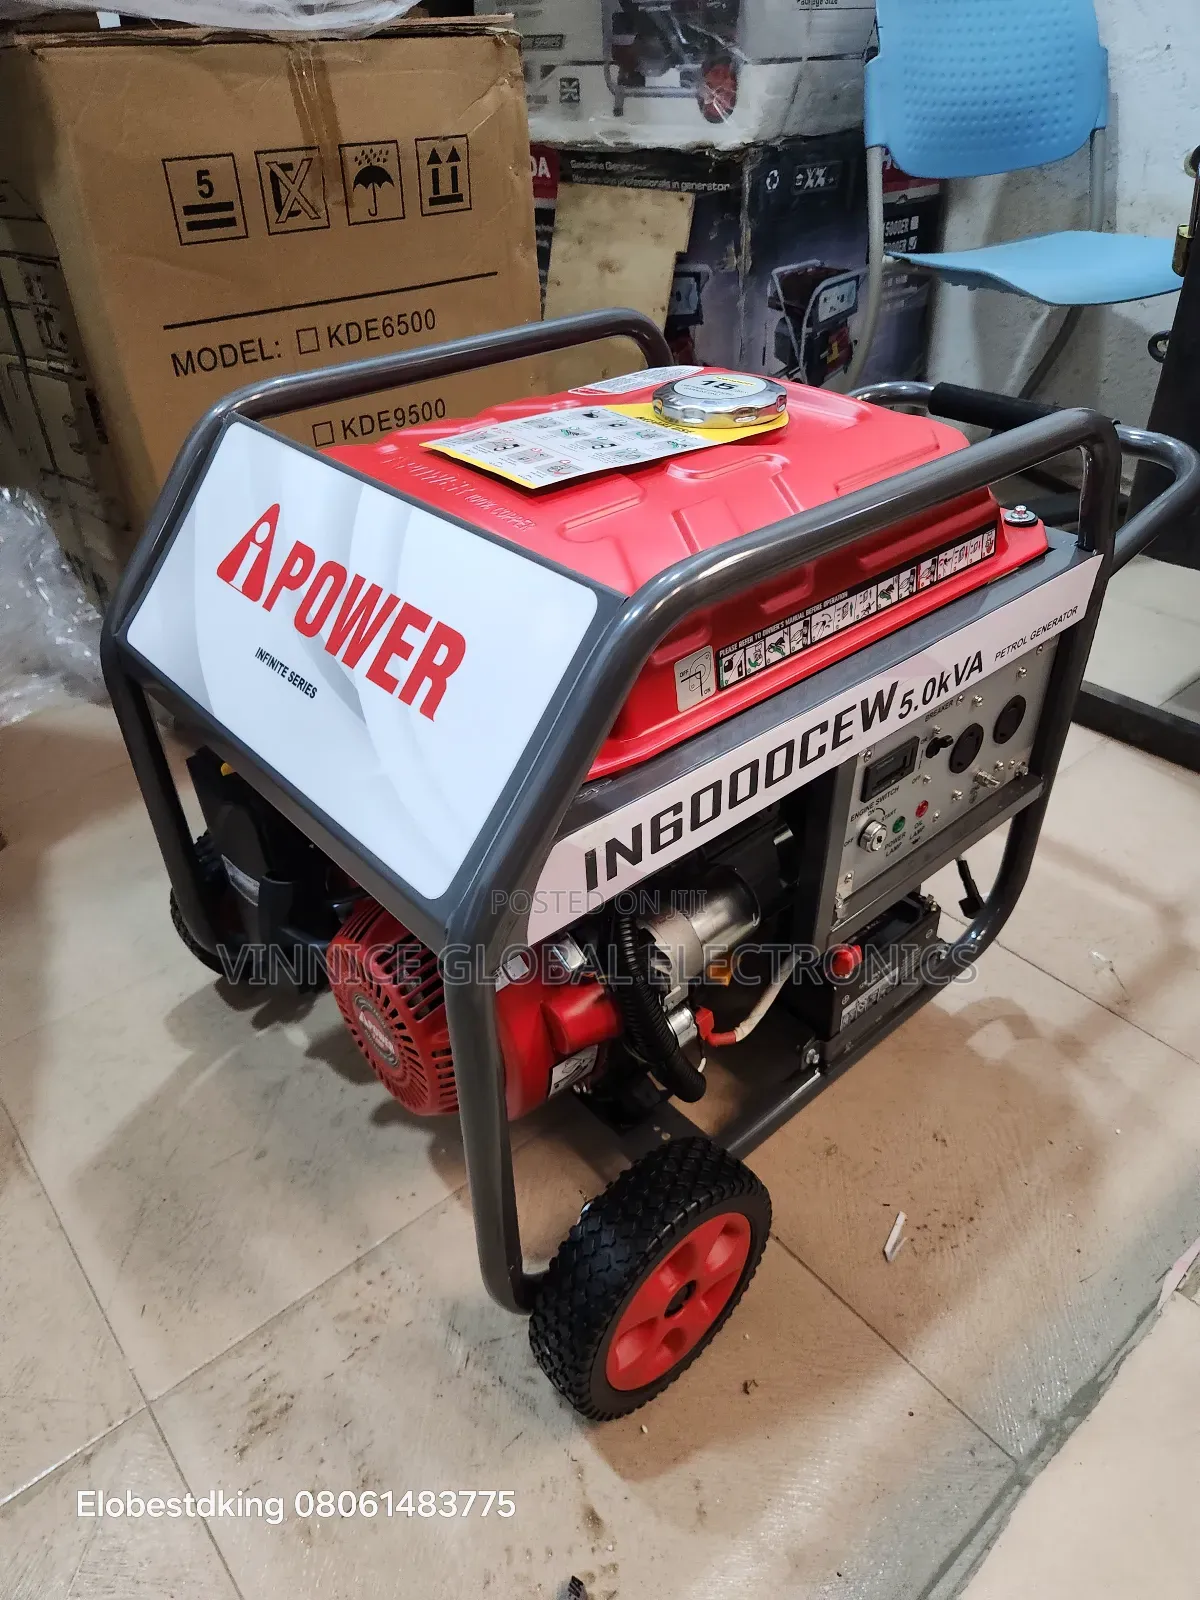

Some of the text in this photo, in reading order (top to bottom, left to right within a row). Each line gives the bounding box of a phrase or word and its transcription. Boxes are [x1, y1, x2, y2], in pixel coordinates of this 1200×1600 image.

[196, 169, 215, 199] 5
[681, 181, 731, 192] generator
[170, 308, 437, 378] MODEL: KDE6500
[340, 398, 447, 442] KDE9500
[719, 642, 738, 658] PLEASE
[738, 636, 754, 650] REFER
[754, 632, 763, 641] TO
[785, 611, 806, 627] MANUAL
[805, 602, 824, 618] BEFORE
[823, 590, 849, 608] OPERATION
[255, 646, 318, 699] INFINITE SERIES
[679, 669, 690, 678] OFF
[924, 699, 954, 722] BREAKER
[584, 605, 1079, 893] IN6000CEW 5.0kVA PETROL GENERATOR
[850, 785, 900, 822] ENGINE SWITCH
[884, 831, 907, 851] POWER
